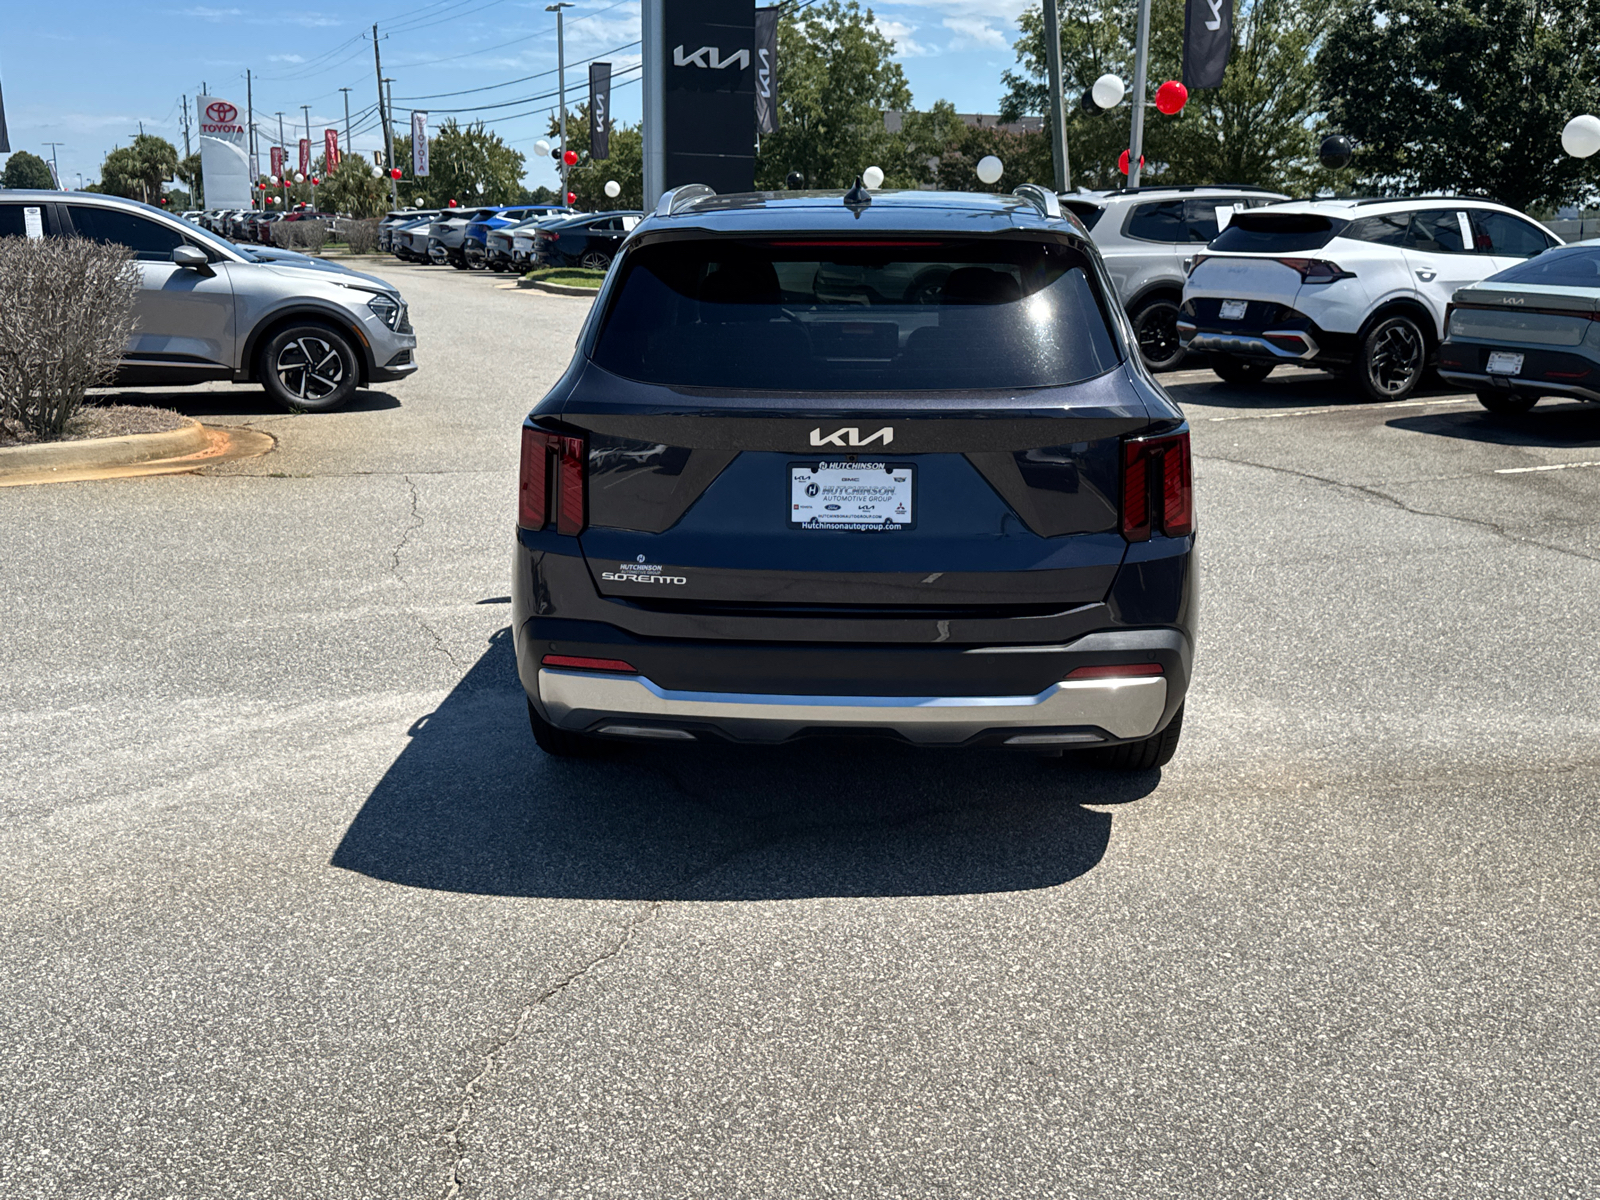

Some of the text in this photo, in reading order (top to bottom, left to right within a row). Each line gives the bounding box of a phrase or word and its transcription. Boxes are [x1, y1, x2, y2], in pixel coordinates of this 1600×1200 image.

[673, 44, 750, 71] KIA
[759, 48, 771, 98] KIA
[201, 124, 245, 134] TOYOTA
[417, 125, 426, 172] TOYOTA
[809, 427, 894, 446] KIA
[829, 462, 886, 470] HUTCHINSON
[821, 486, 896, 496] HUTCHINSON
[802, 522, 902, 531] Hutchinsonautogroup.com
[620, 563, 663, 571] HUTCHINSON
[602, 571, 687, 585] SORENTO
